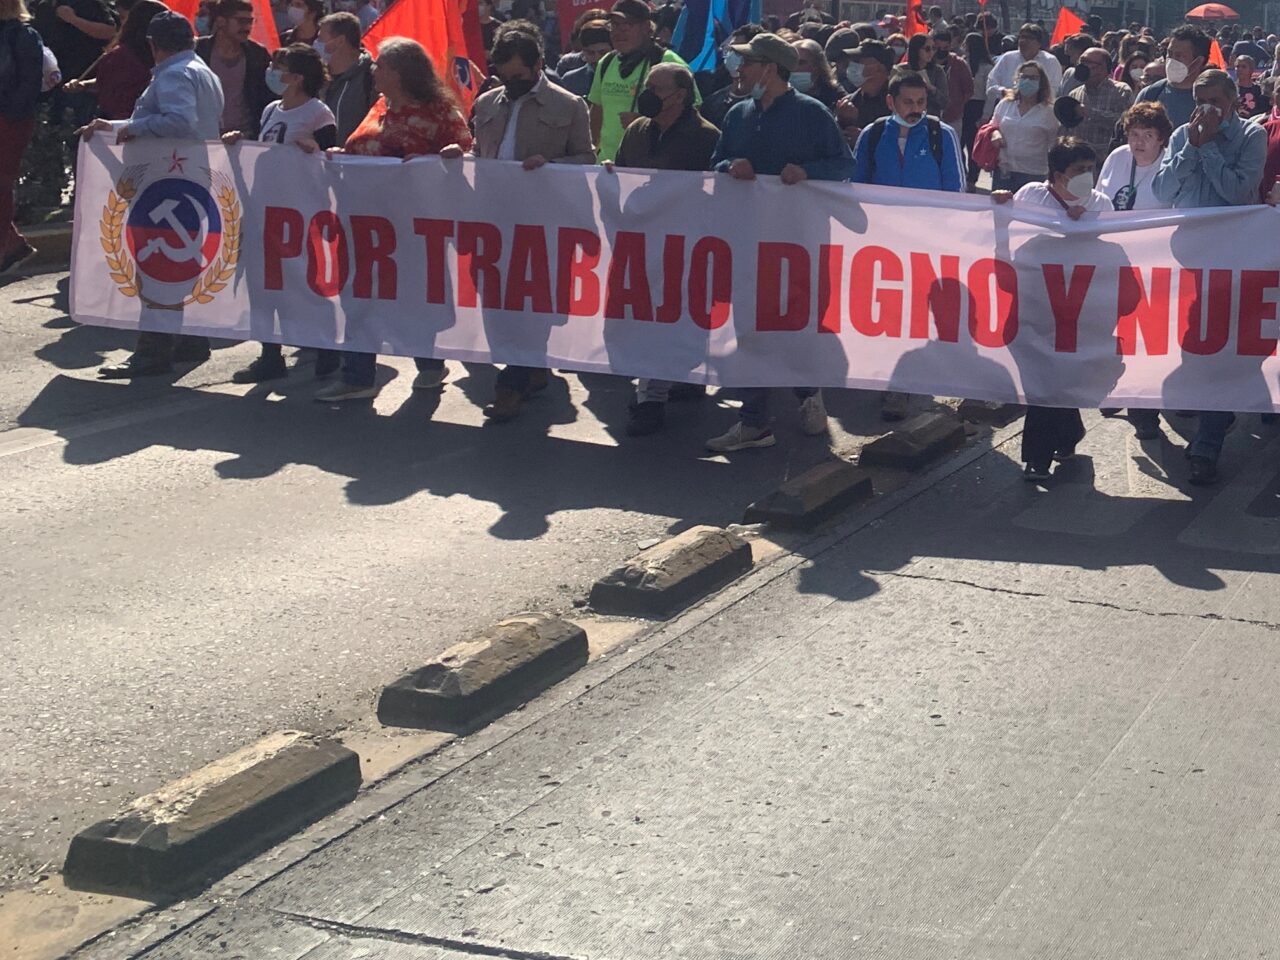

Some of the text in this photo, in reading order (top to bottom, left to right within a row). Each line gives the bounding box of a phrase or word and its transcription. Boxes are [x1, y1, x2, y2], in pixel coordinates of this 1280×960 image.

[264, 206, 397, 300] POR
[413, 217, 733, 330] TRABAJO
[755, 241, 1019, 349] DIGNO
[1041, 263, 1096, 354] Y
